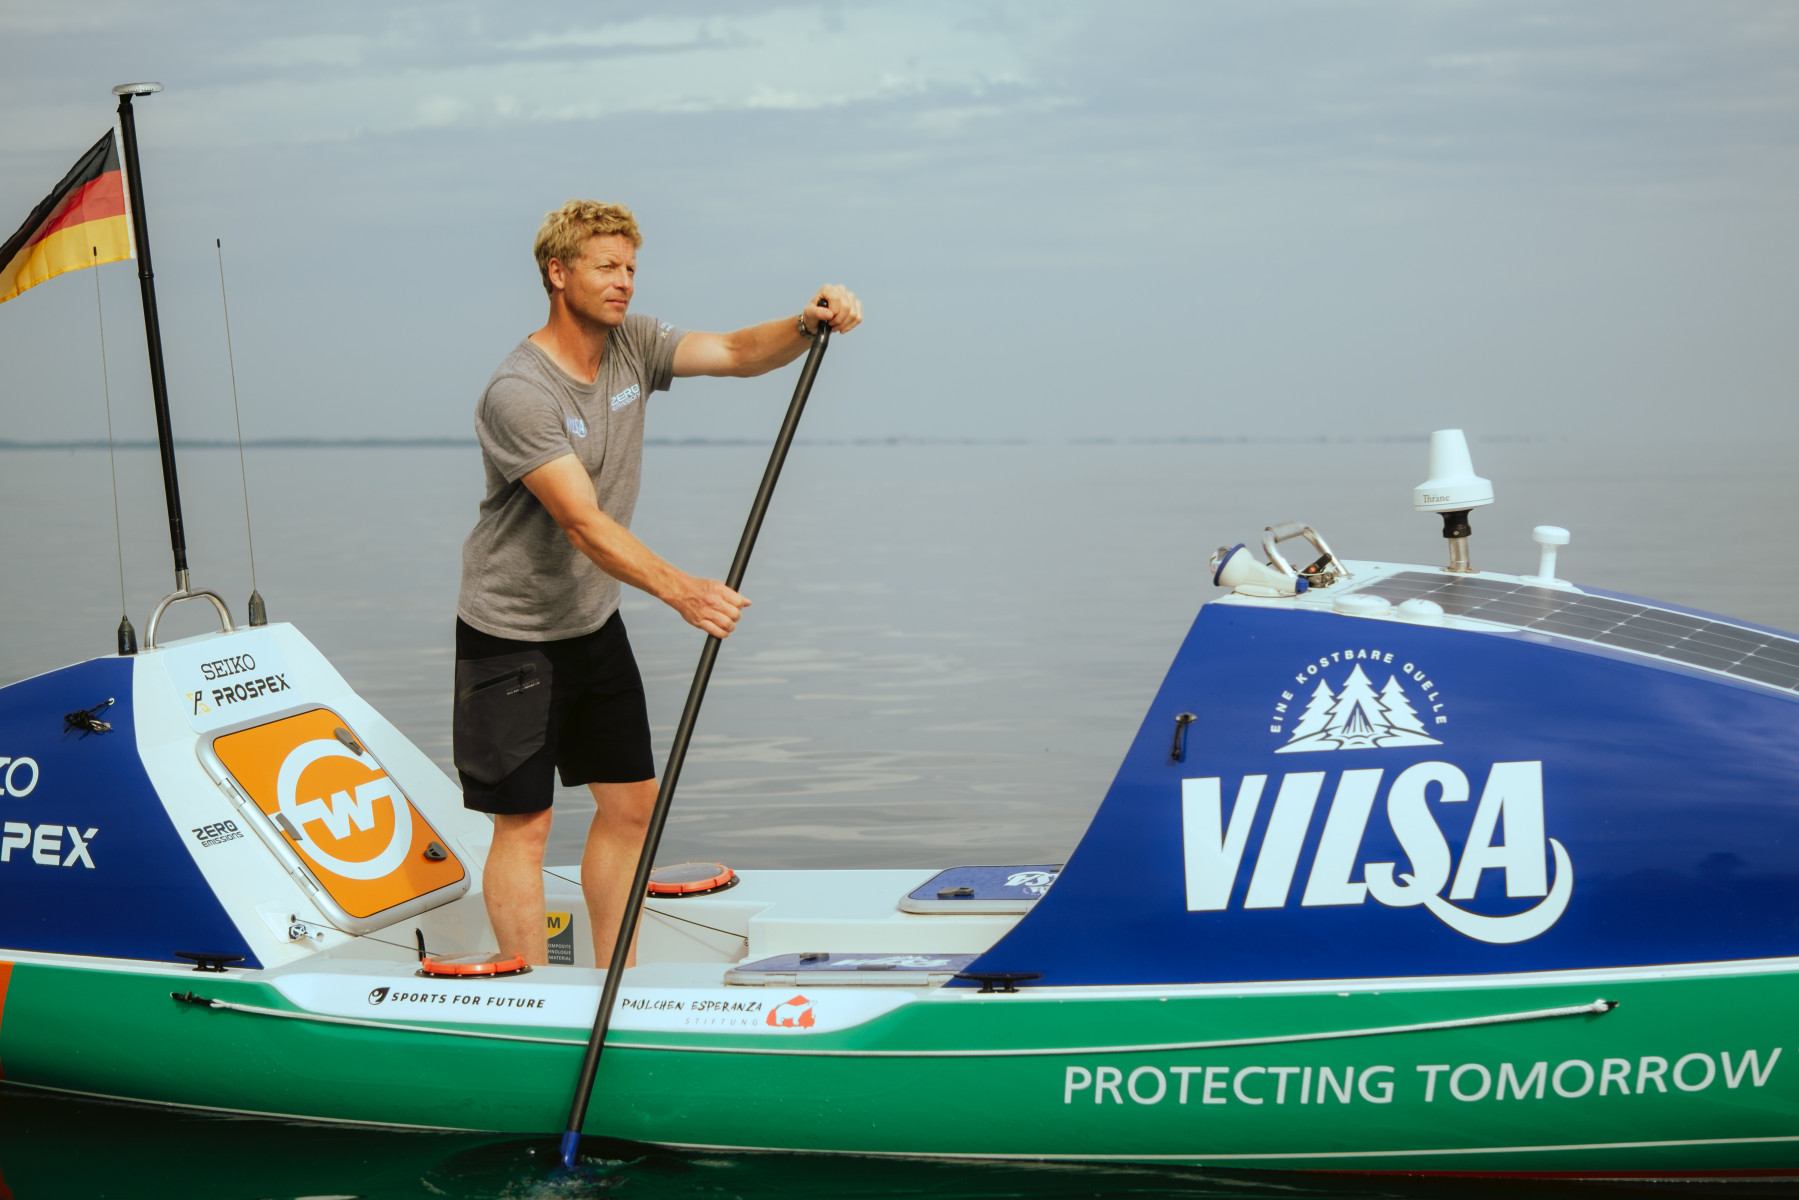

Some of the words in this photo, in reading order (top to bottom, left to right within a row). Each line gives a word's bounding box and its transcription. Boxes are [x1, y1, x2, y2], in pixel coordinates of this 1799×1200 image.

[610, 383, 640, 407] ZERO
[1422, 494, 1451, 504] Thrane
[200, 653, 256, 681] SEIKO
[212, 673, 291, 707] PROSPEX
[1270, 690, 1294, 733] EINE
[1295, 649, 1394, 684] KOSTBARE
[1403, 662, 1447, 724] QUELLE
[191, 819, 239, 841] ZERO
[1181, 760, 1574, 944] VILSA
[547, 916, 561, 929] M
[391, 992, 447, 1004] SPORTS
[452, 995, 481, 1006] FOR
[486, 997, 546, 1009] FUTURE
[621, 998, 685, 1011] PAULCHEN
[691, 1000, 763, 1013] ESPERANZA
[685, 1017, 759, 1027] STIFTUNG
[1063, 1065, 1396, 1105] PROTECTING
[1415, 1047, 1783, 1103] TOMORROW
